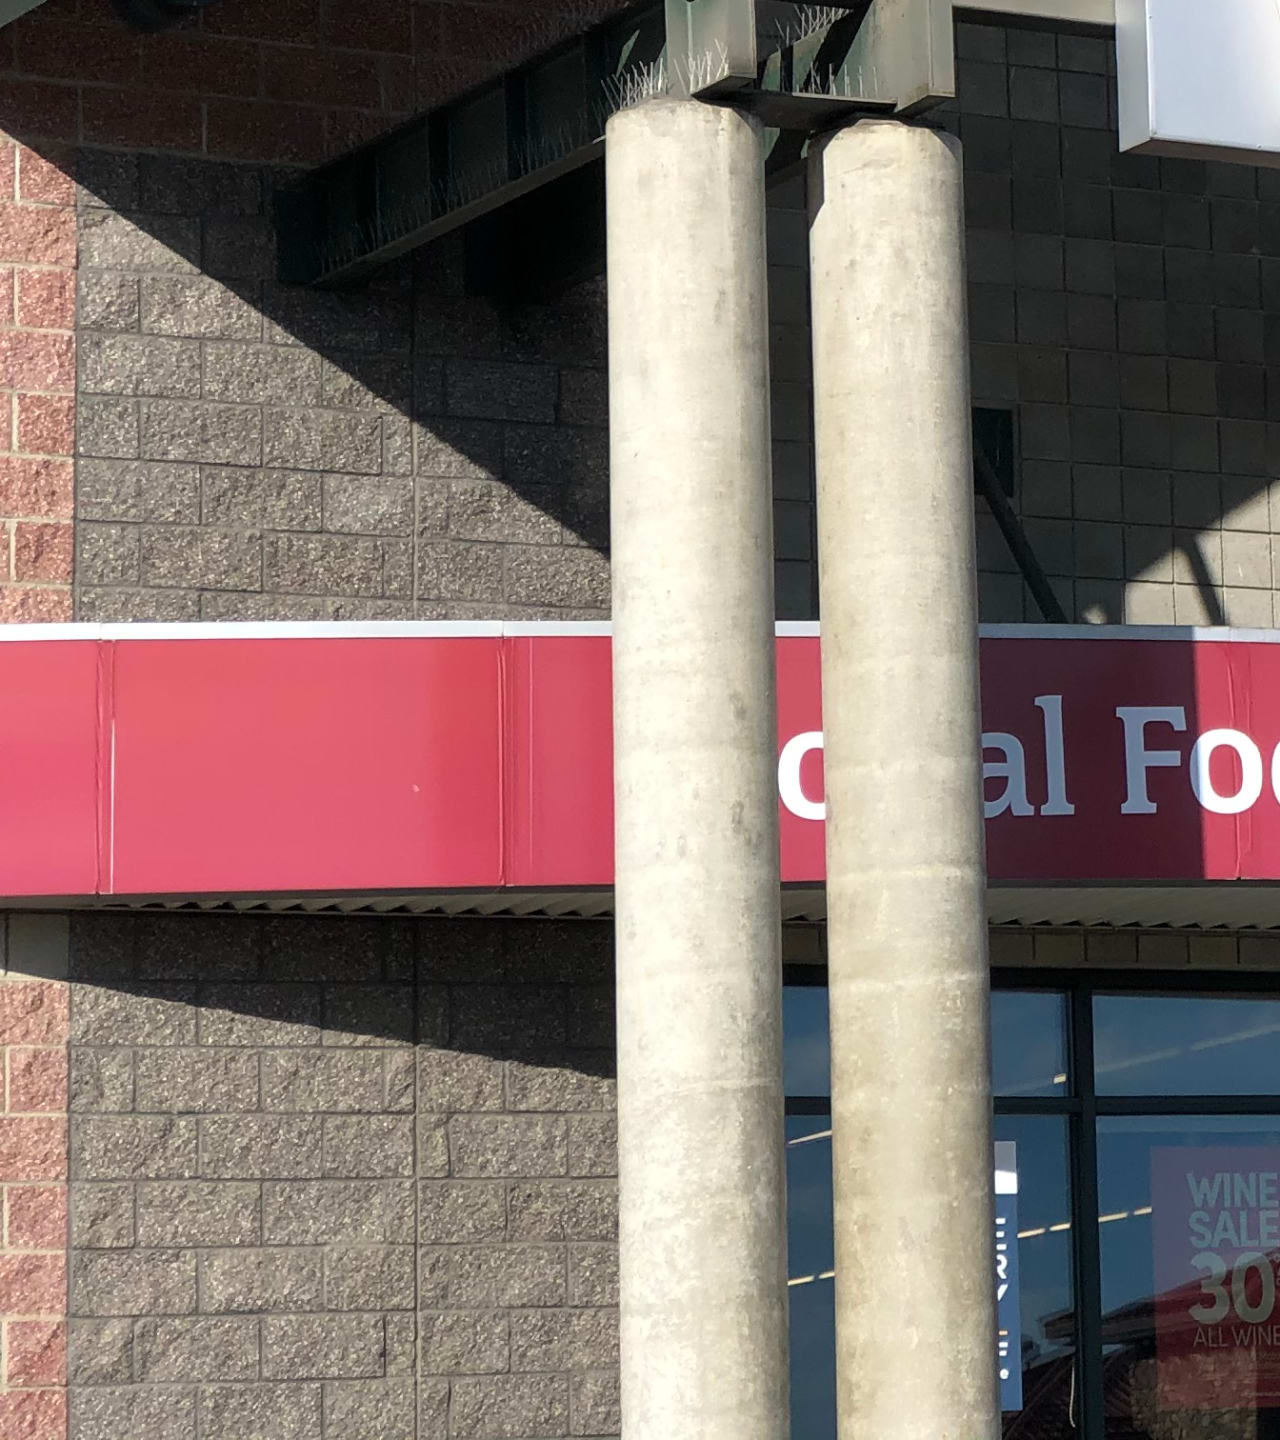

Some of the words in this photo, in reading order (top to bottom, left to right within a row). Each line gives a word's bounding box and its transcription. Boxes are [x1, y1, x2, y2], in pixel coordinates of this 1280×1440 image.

[1185, 1171, 1280, 1208] WINE
[1188, 1210, 1280, 1248] SALE
[1193, 1326, 1228, 1348] ALL
